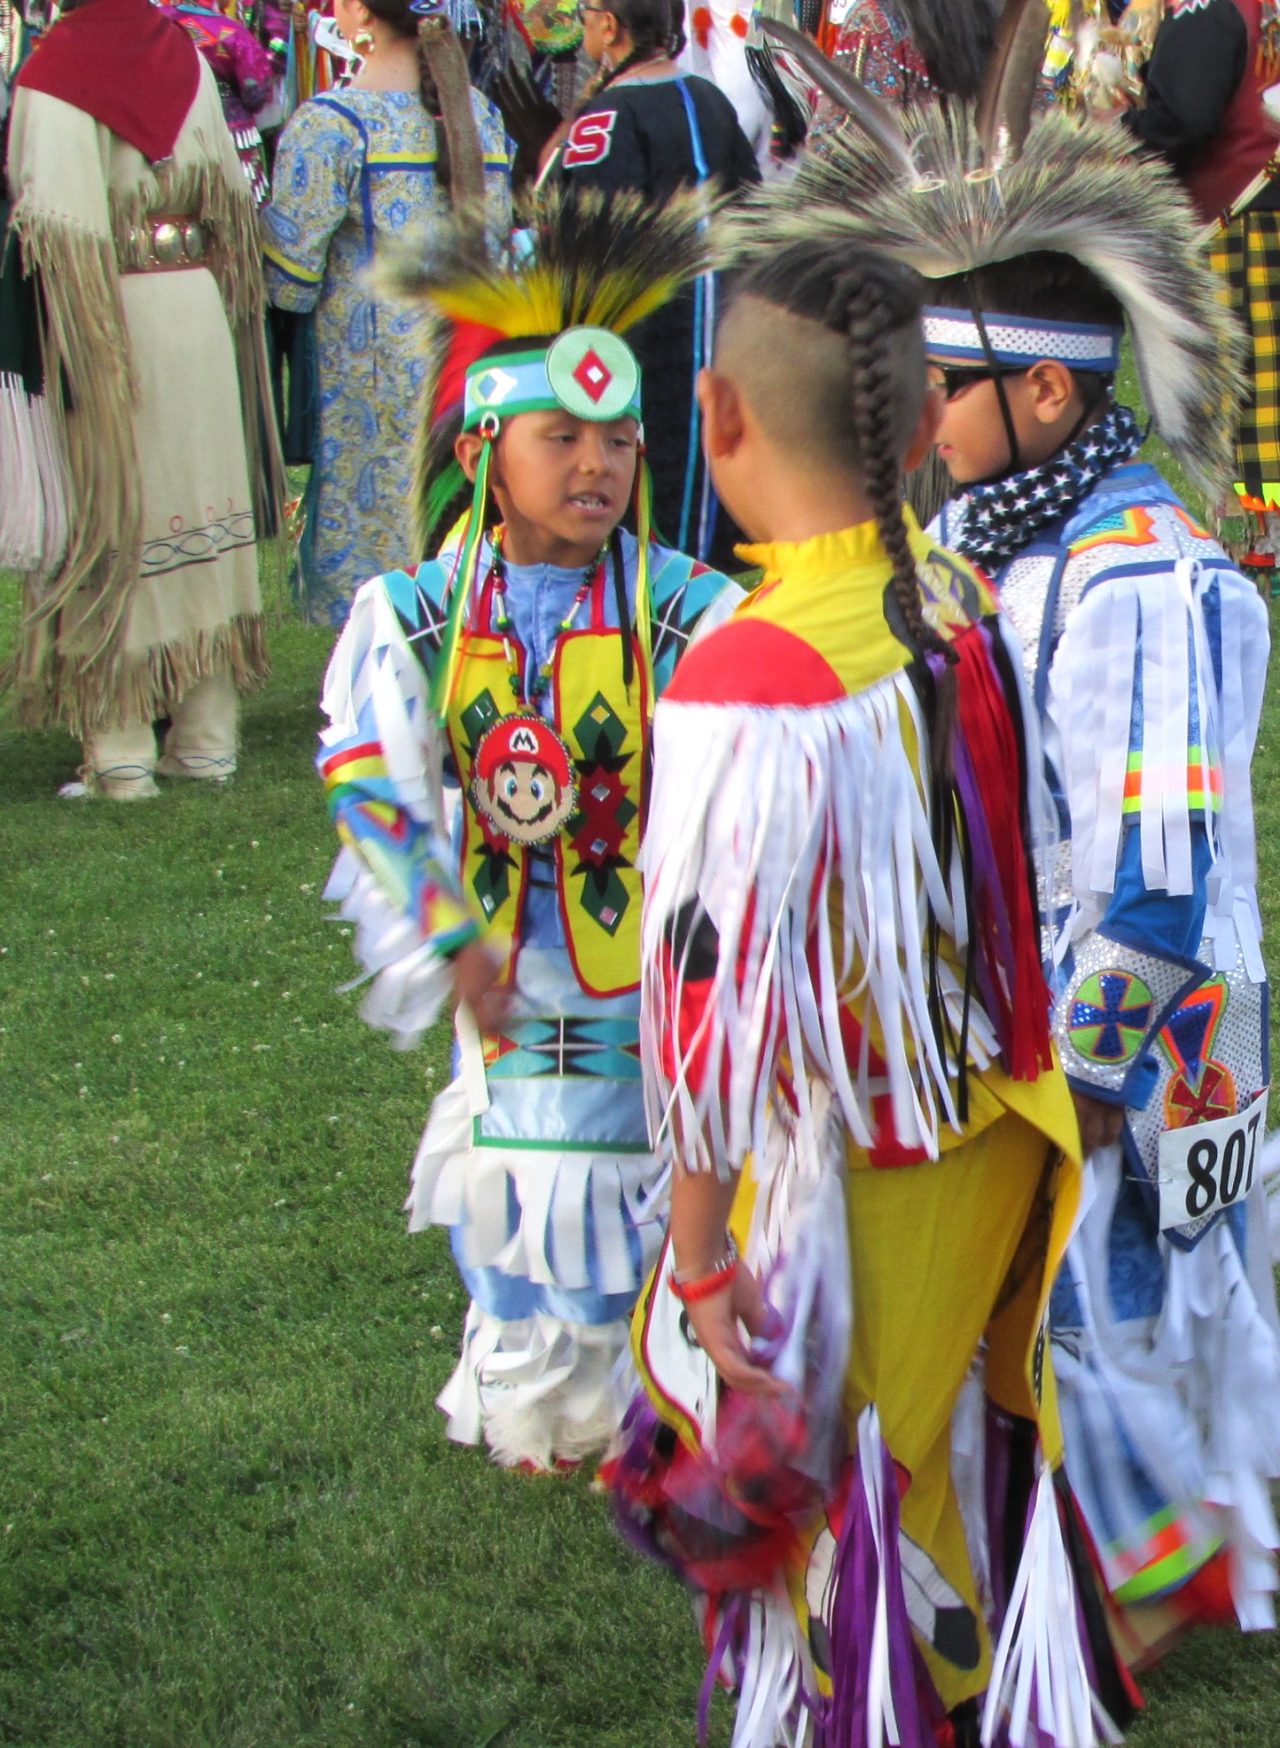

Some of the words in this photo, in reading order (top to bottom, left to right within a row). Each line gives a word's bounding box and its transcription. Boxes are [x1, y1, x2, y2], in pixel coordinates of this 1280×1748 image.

[562, 110, 618, 169] S
[512, 731, 536, 751] M
[1185, 1110, 1262, 1218] 807
